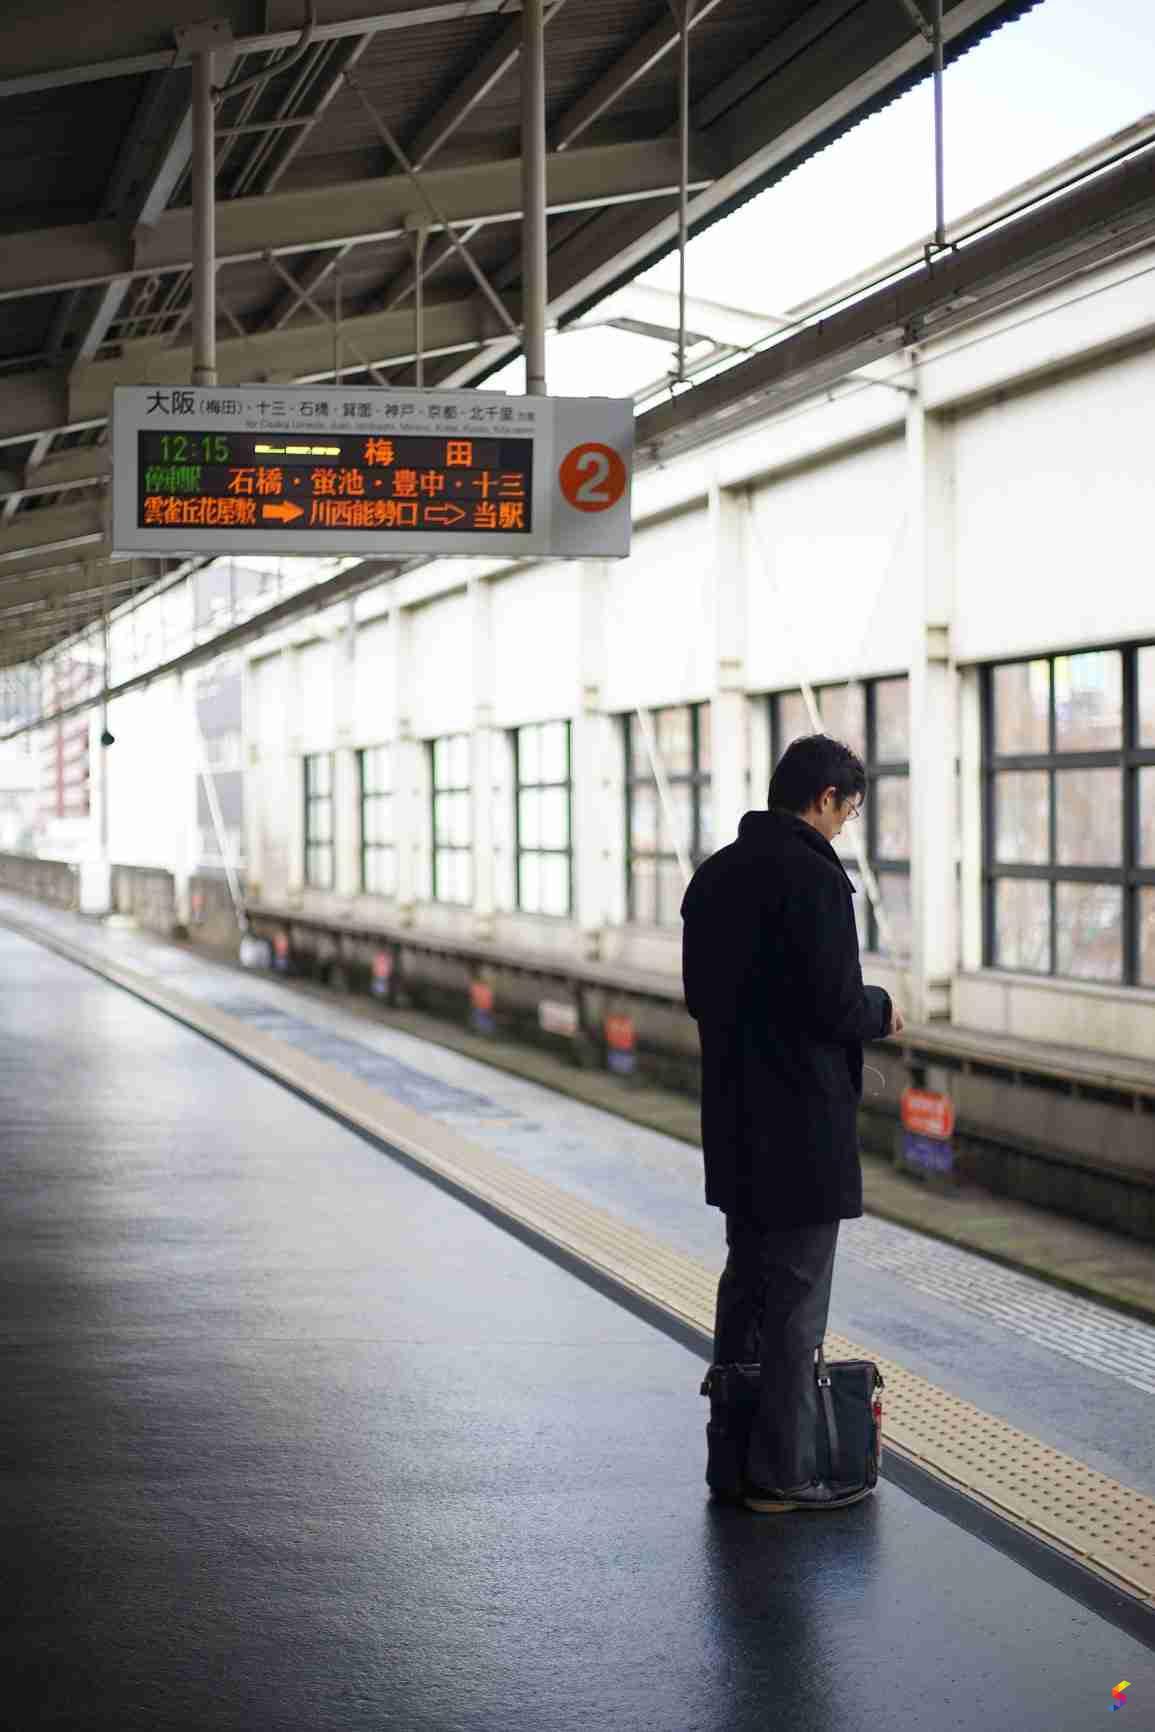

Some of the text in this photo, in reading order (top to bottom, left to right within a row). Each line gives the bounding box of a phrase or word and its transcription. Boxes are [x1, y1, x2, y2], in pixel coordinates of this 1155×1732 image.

[160, 435, 230, 463] 12:15
[576, 451, 608, 501] 2
[473, 501, 525, 528] 当駅
